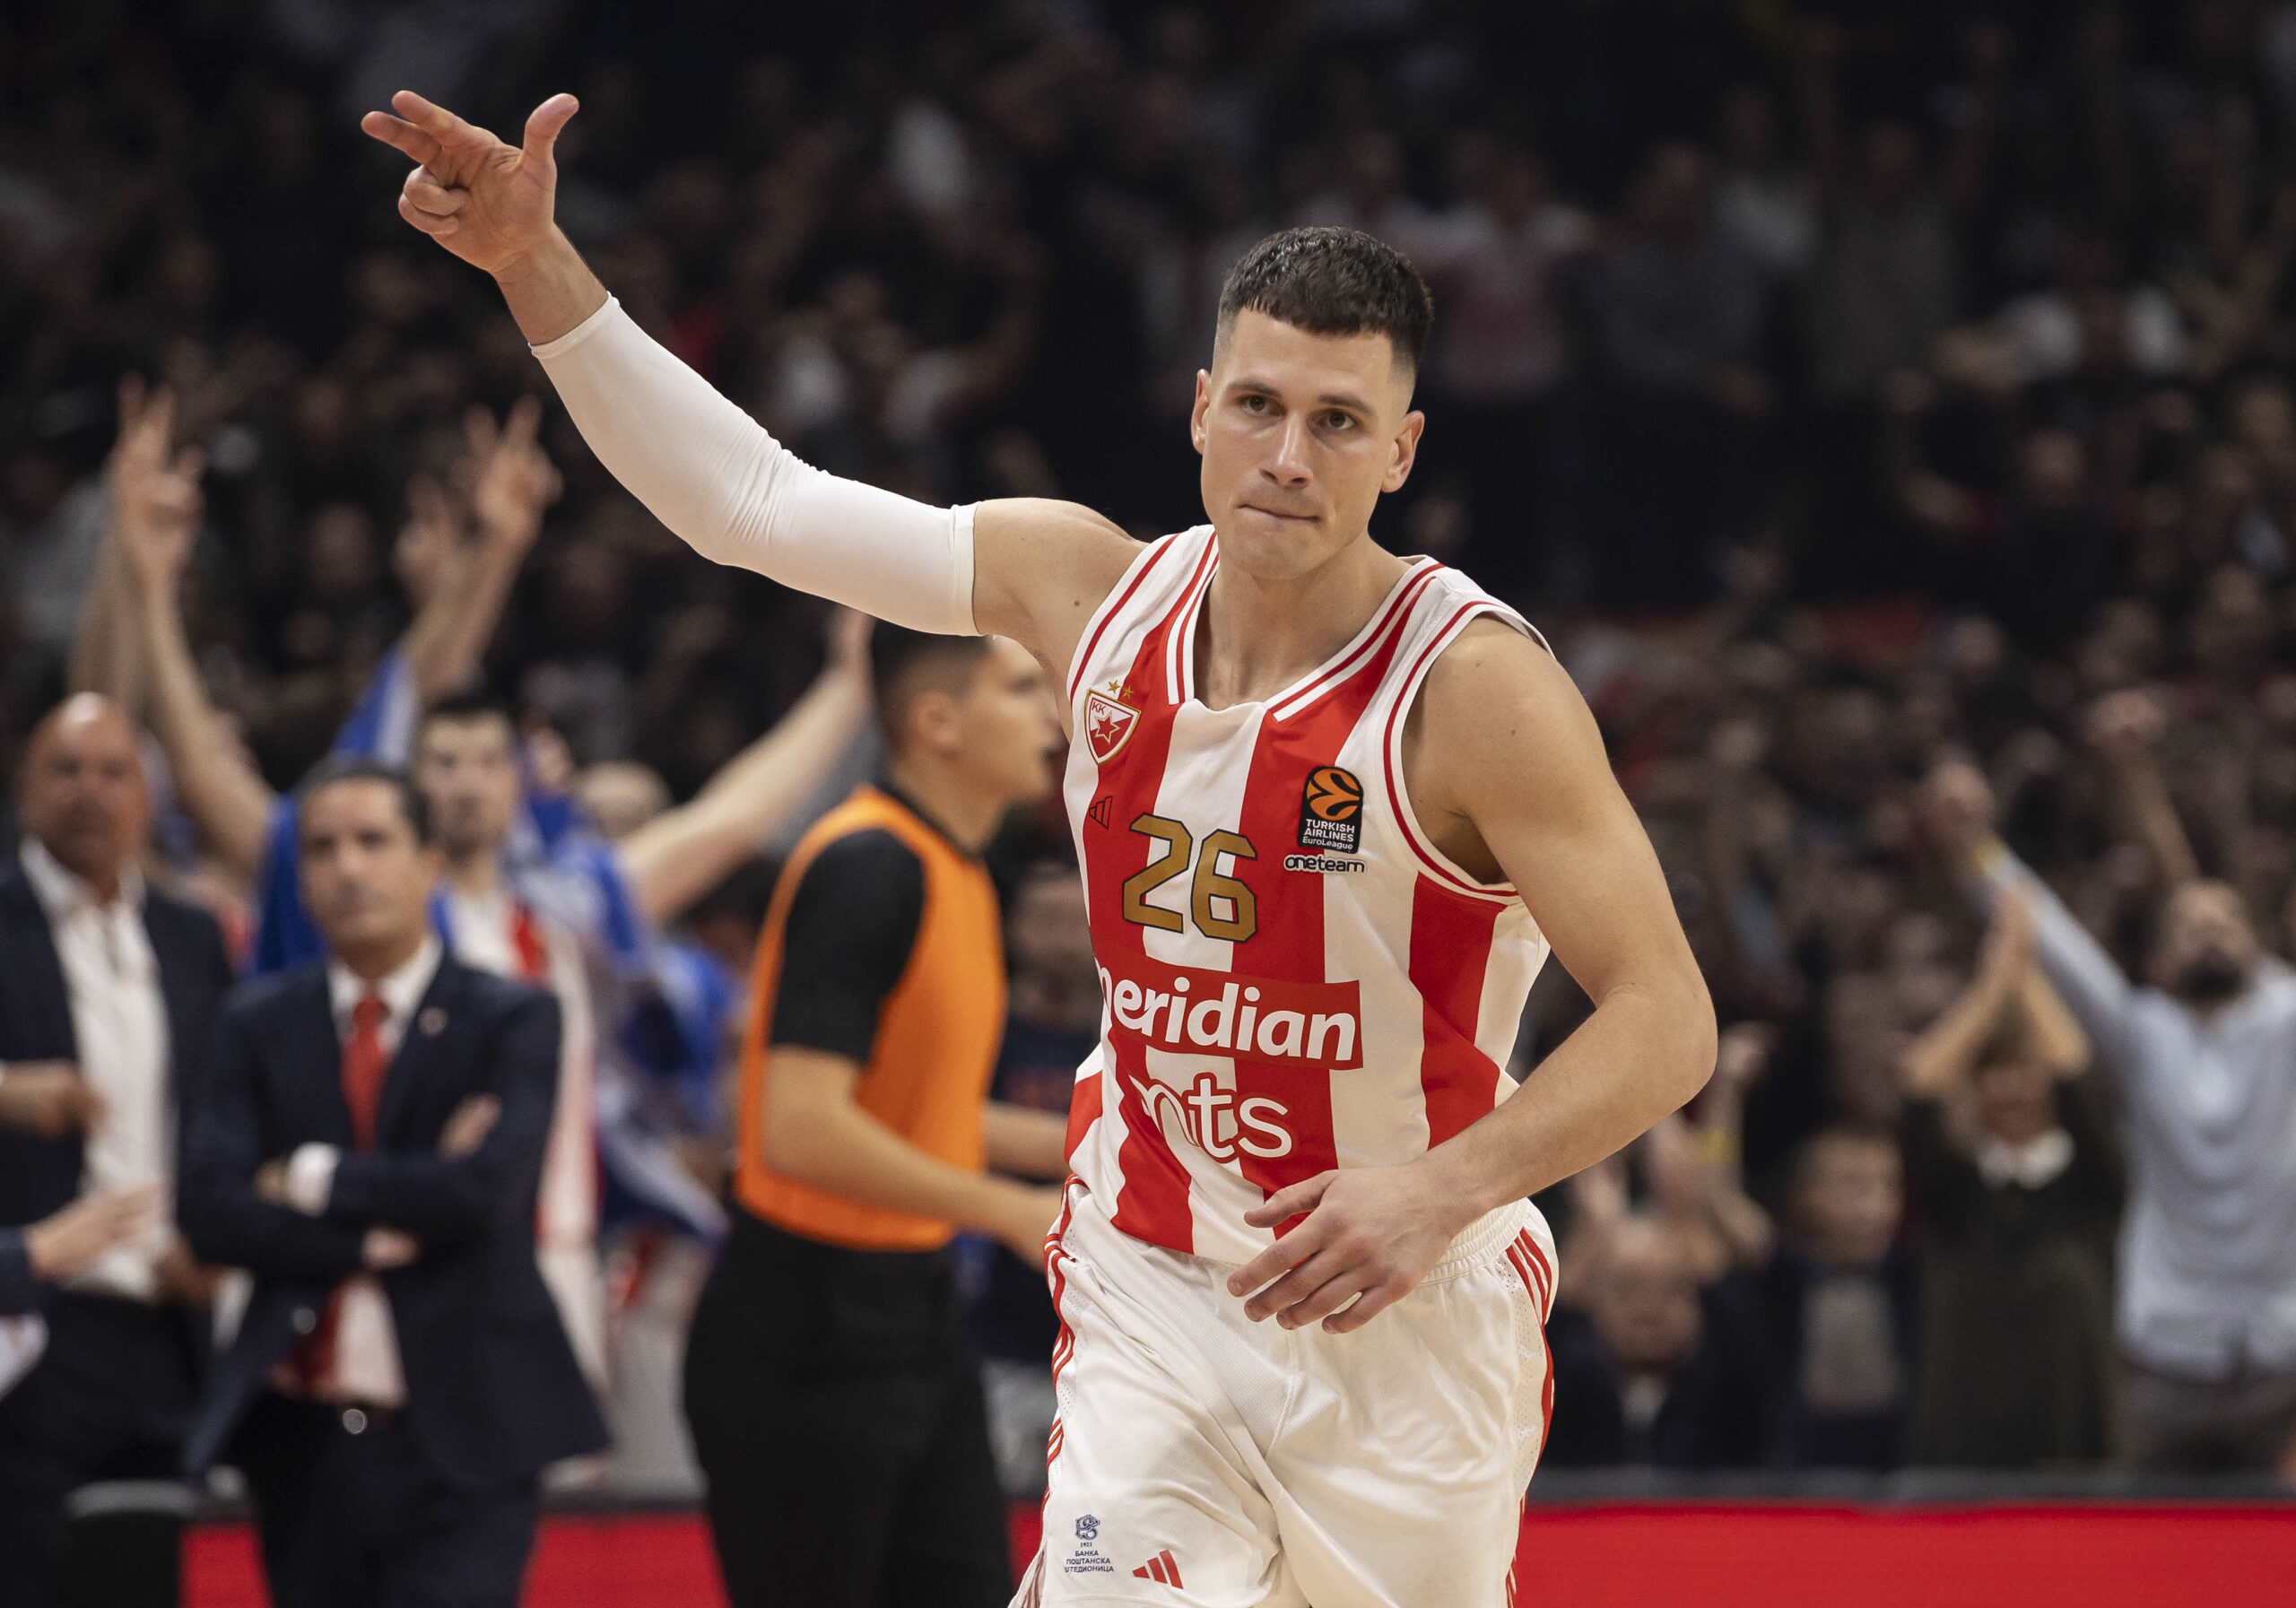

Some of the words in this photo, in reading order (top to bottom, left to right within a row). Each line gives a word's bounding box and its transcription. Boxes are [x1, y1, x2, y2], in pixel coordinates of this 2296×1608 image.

[1305, 818, 1355, 834] TURKISH
[1304, 828, 1354, 842] AIRLINES
[1302, 836, 1353, 850] EuroLeague
[1283, 856, 1365, 873] oneteam
[1122, 813, 1257, 943] 26
[1065, 1557, 1111, 1565] ПОШТАНСКА
